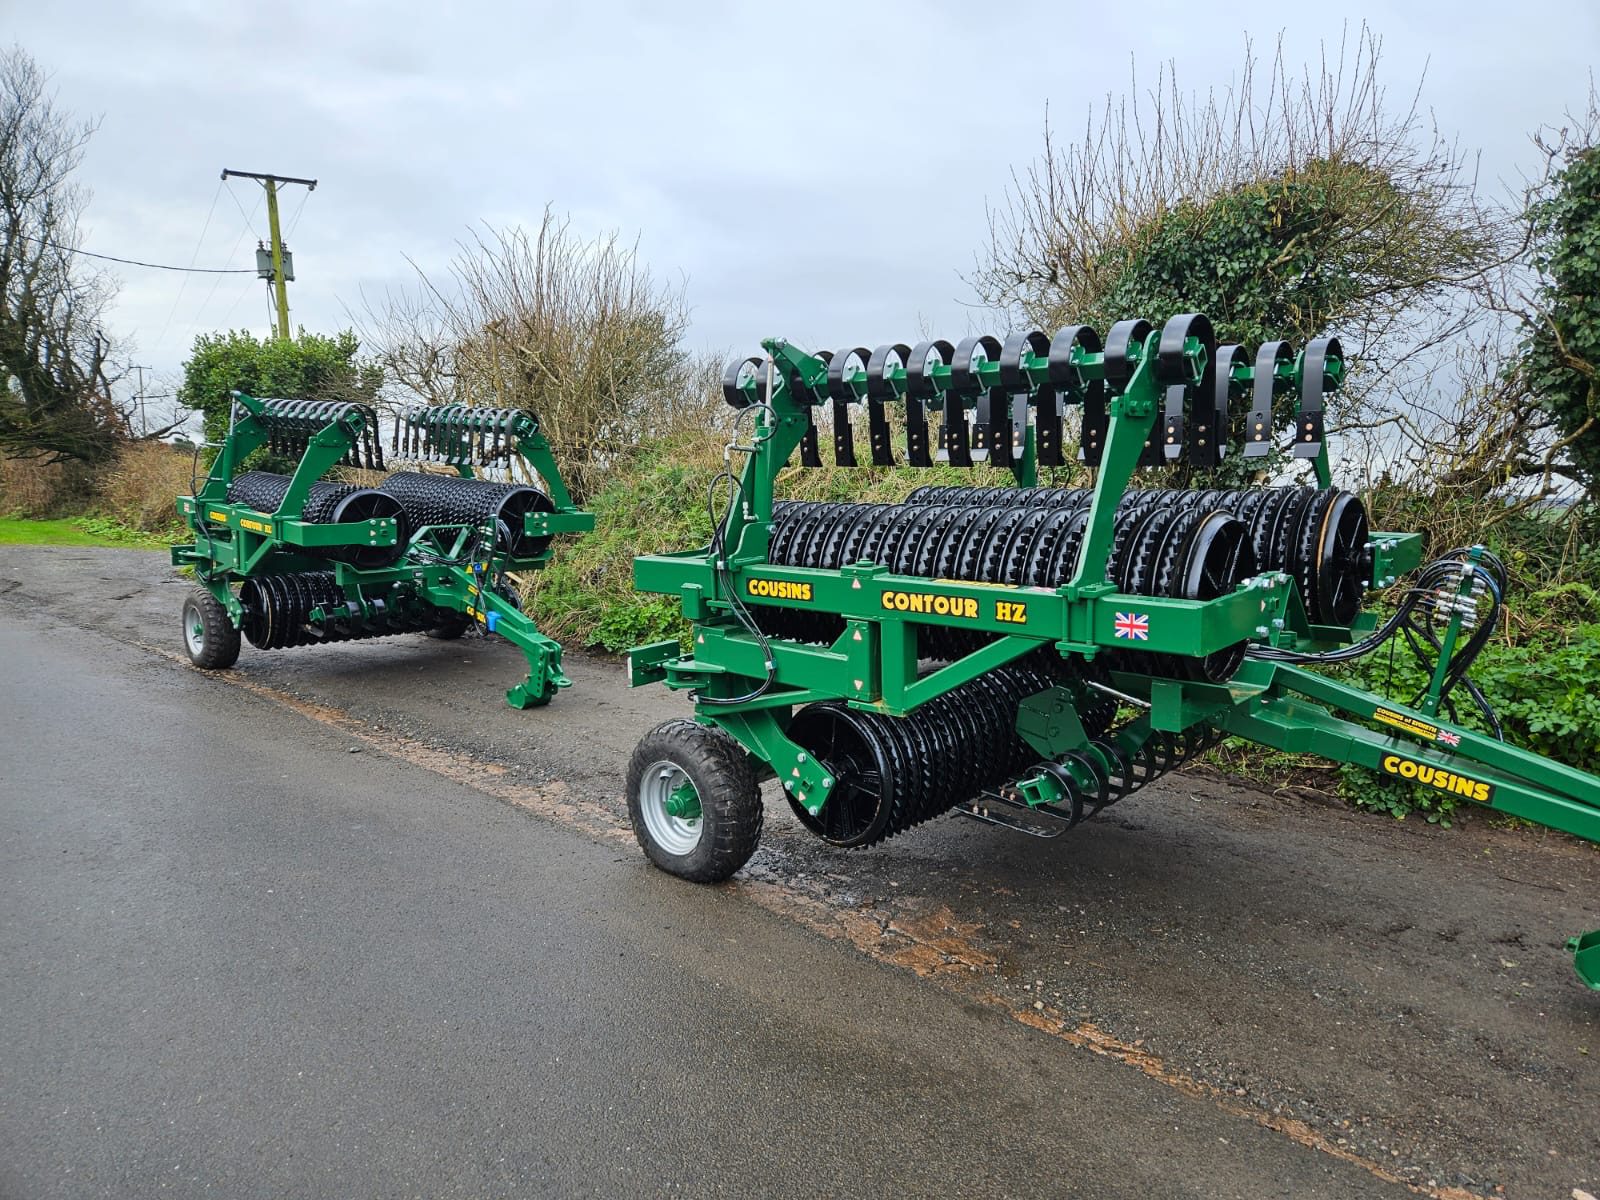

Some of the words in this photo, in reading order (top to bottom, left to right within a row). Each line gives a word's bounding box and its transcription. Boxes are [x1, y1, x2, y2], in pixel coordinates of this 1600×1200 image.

[748, 580, 812, 601] COUSINS
[881, 591, 978, 619] CONTOUR
[995, 601, 1027, 623] HZ
[1383, 755, 1491, 802] COUSINS
